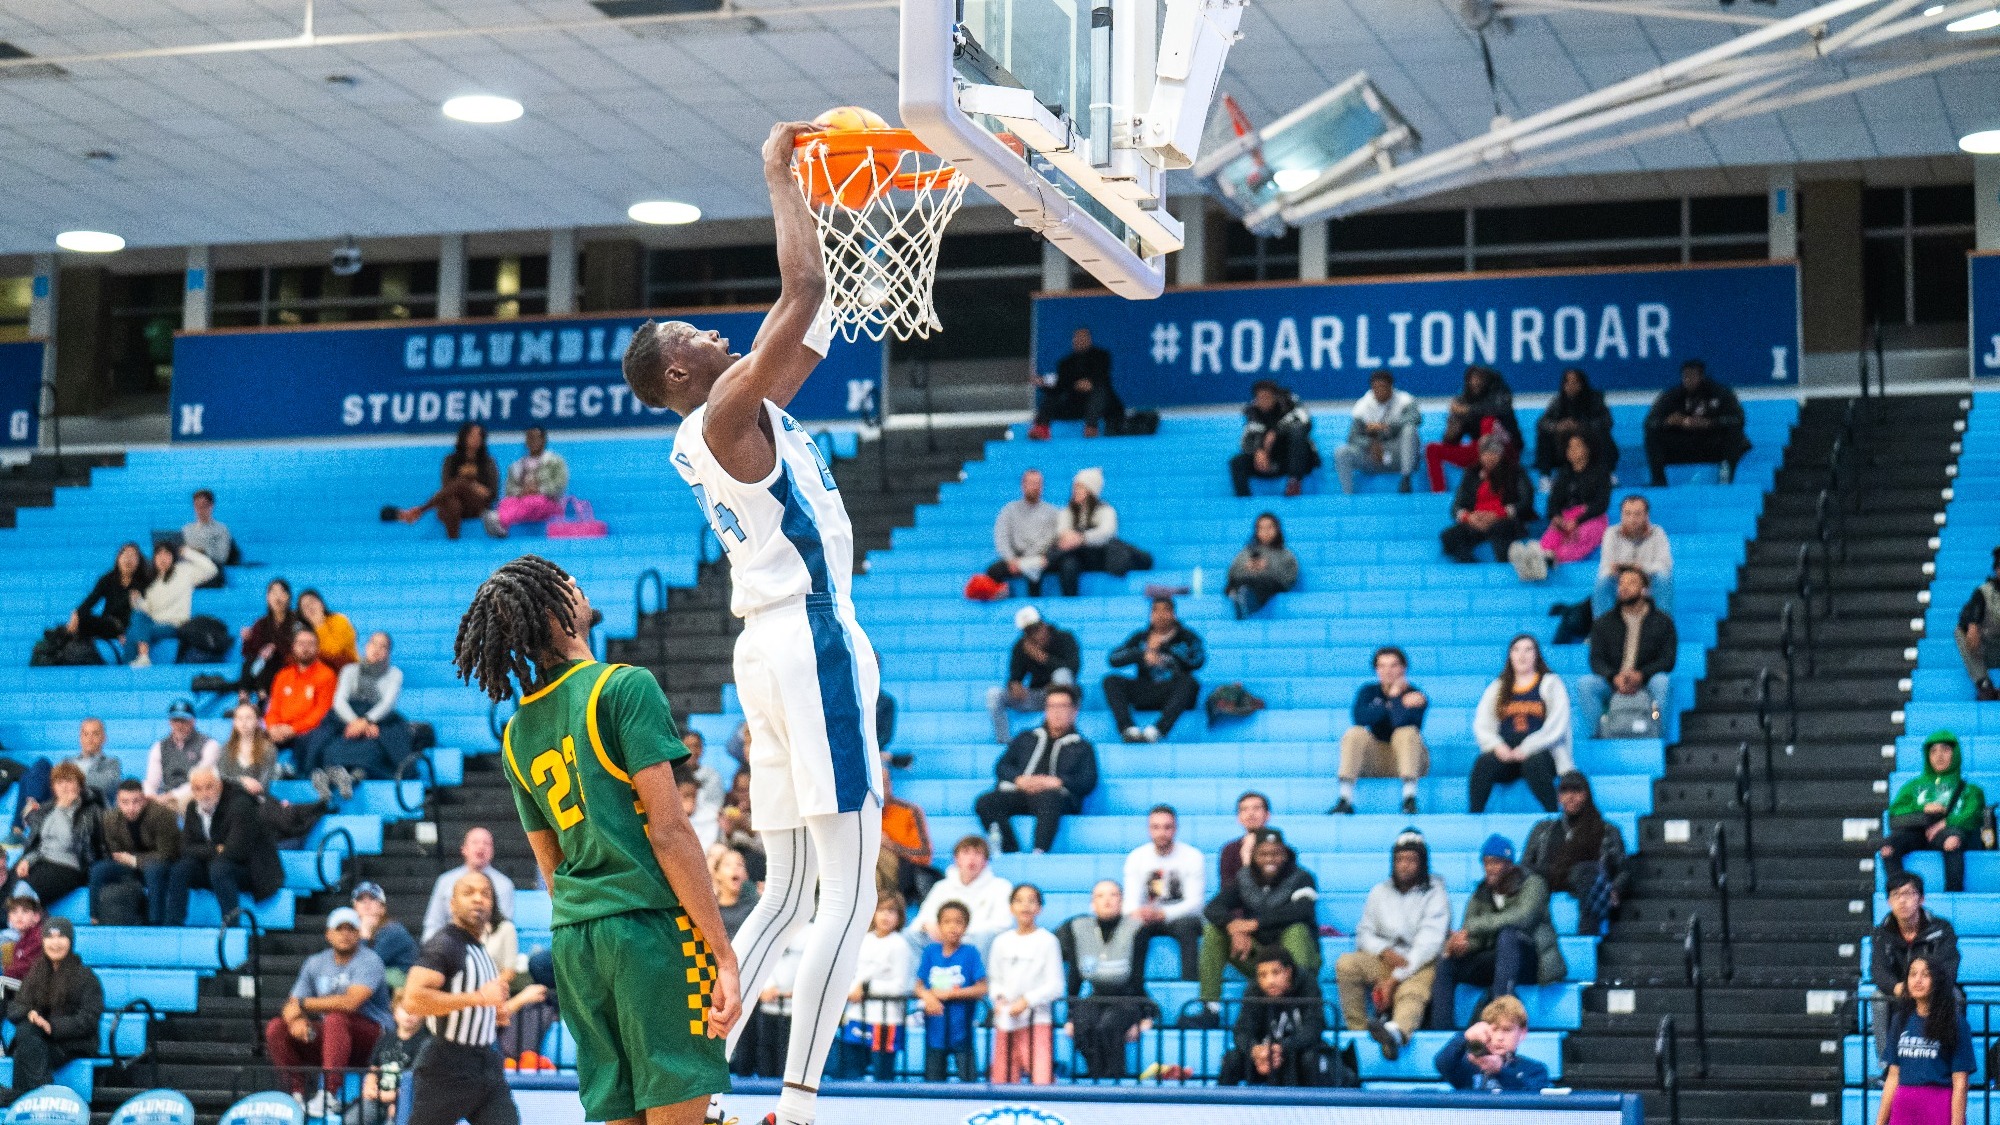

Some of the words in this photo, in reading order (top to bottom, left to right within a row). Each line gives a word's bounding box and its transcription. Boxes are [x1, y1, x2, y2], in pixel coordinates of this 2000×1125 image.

[405, 326, 633, 369] COLUMBIA
[1771, 346, 1788, 380] I
[342, 388, 518, 427] STUDENT
[530, 384, 667, 419] SECTI
[846, 379, 875, 412] K
[10, 410, 29, 440] G
[180, 403, 204, 435] H
